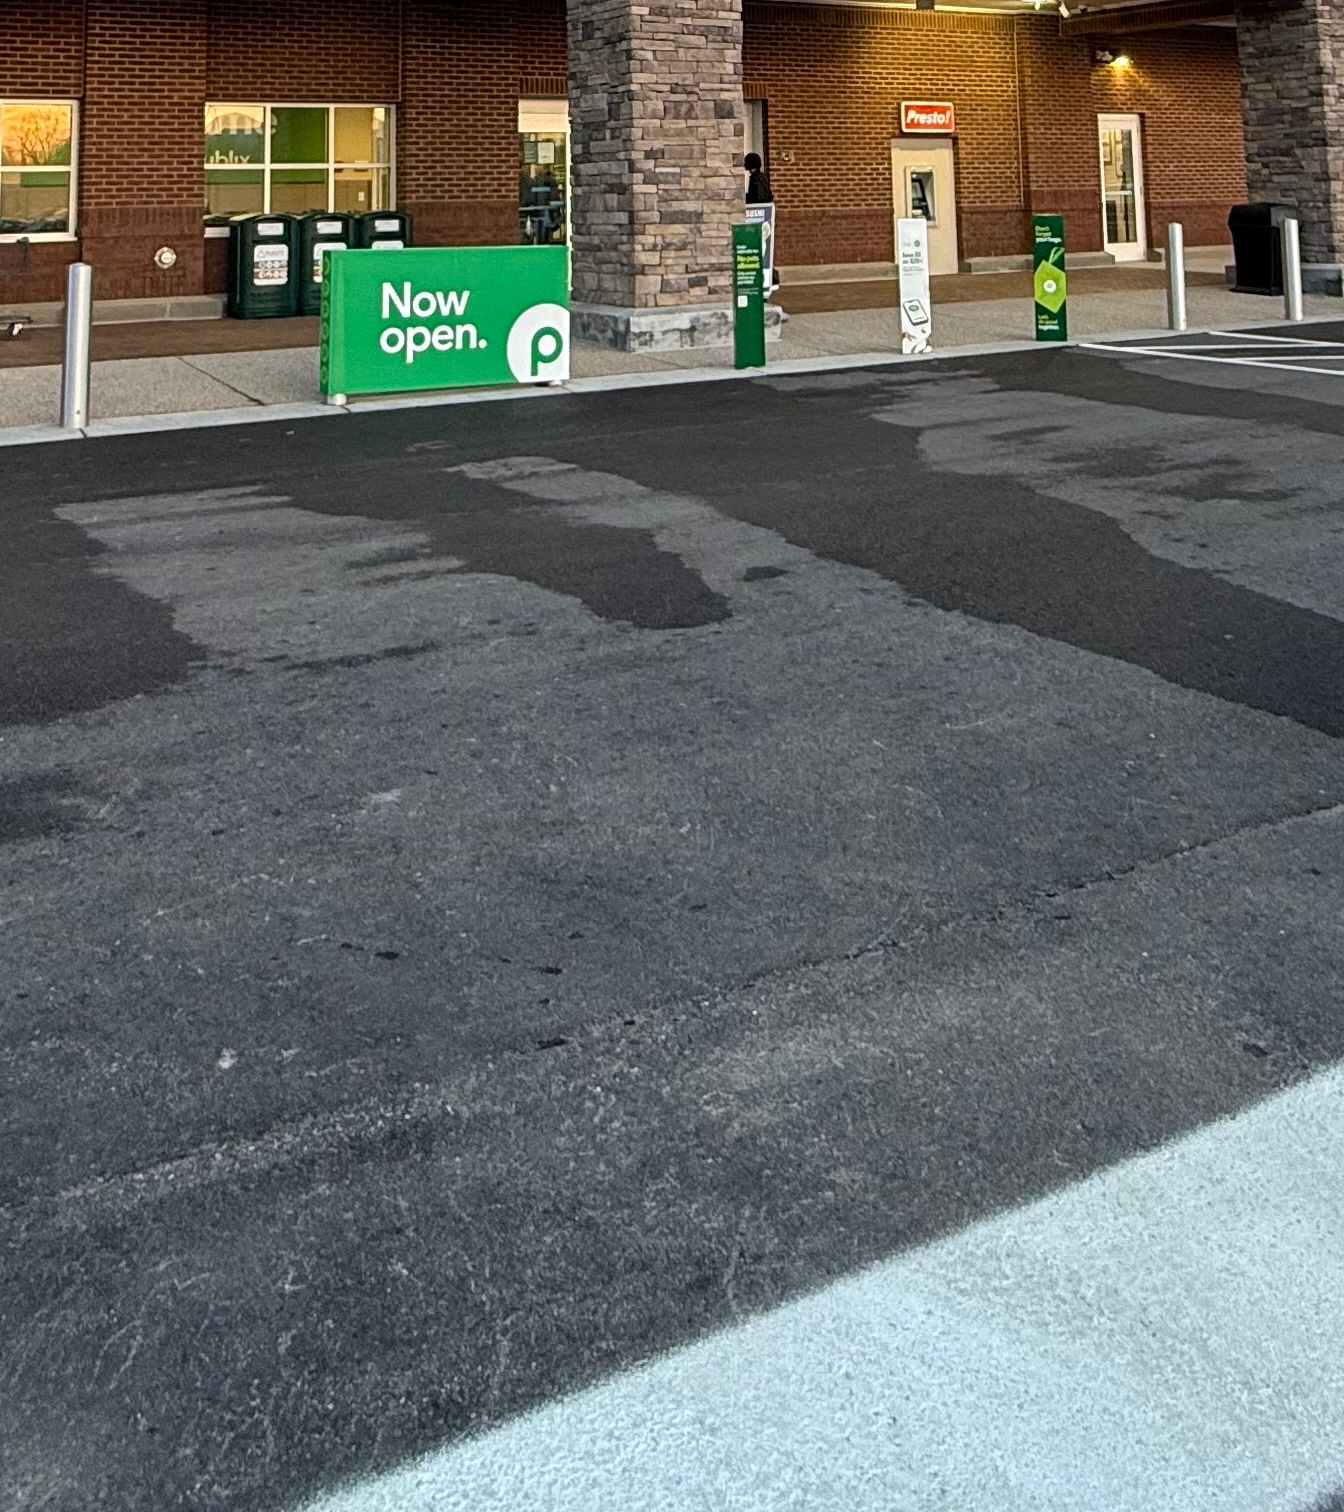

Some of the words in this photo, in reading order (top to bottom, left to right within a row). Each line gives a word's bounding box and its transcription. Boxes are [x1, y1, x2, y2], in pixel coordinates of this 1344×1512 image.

[906, 109, 952, 125] Presto!
[381, 281, 471, 320] Now
[379, 323, 488, 364] open.
